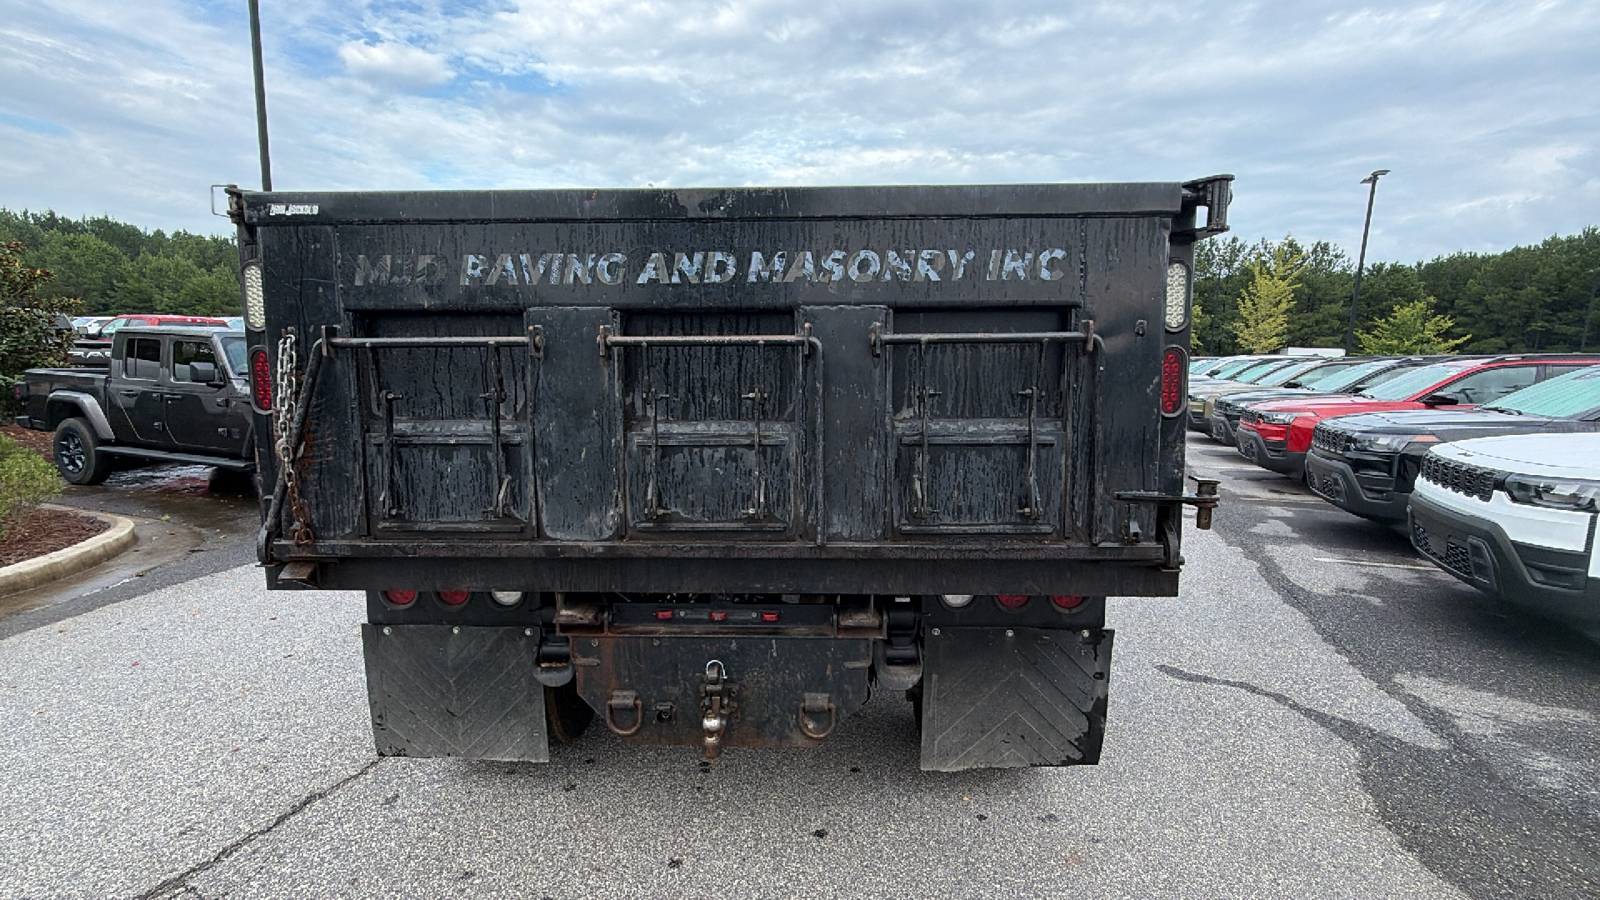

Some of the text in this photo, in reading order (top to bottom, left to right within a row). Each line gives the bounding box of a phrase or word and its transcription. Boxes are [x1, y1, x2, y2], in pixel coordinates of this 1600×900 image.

[459, 252, 628, 287] PAVING
[636, 251, 736, 285] AND
[746, 249, 976, 283] MASONRY
[986, 248, 1067, 281] INC
